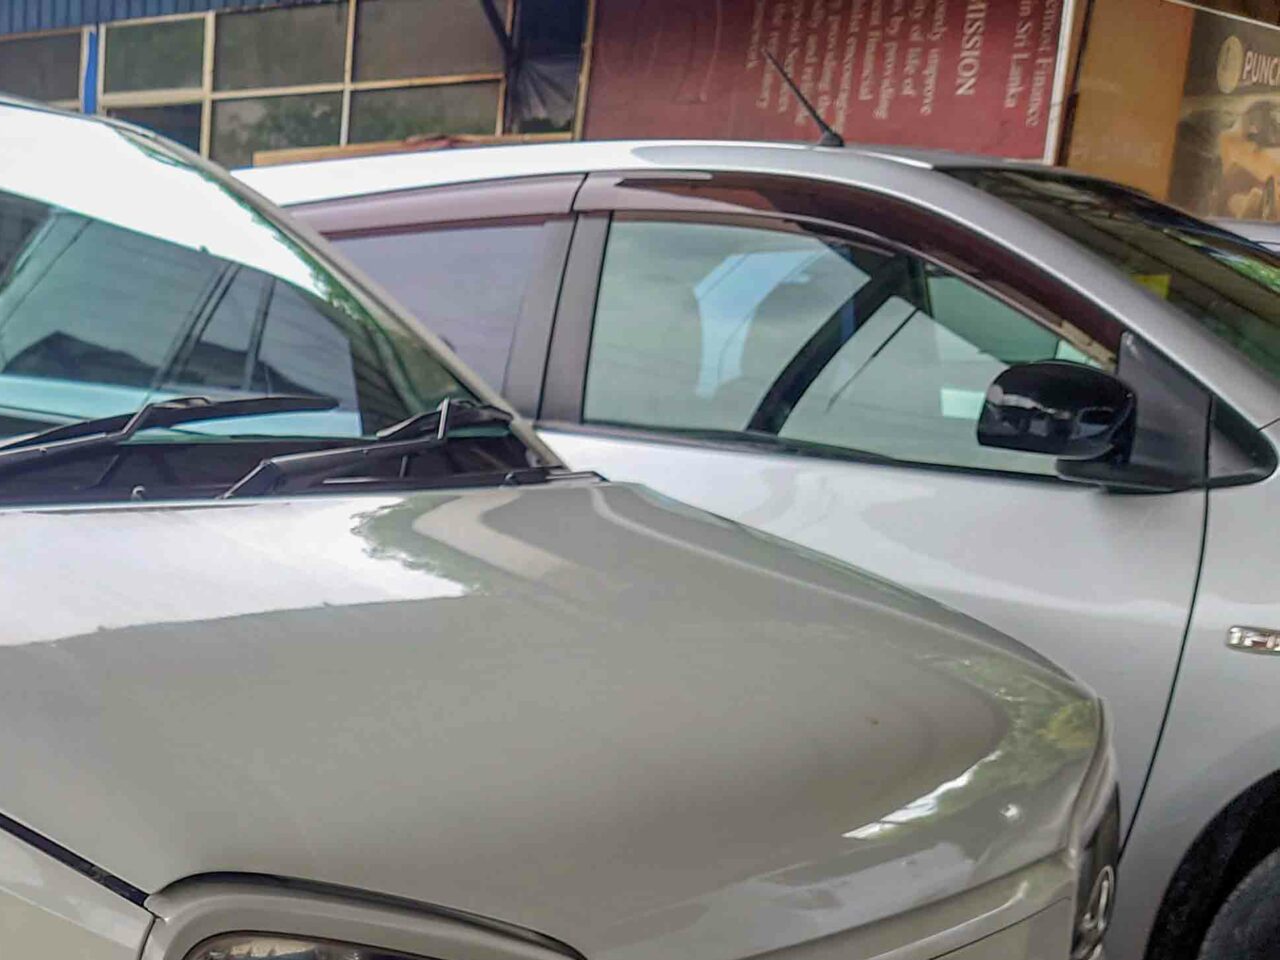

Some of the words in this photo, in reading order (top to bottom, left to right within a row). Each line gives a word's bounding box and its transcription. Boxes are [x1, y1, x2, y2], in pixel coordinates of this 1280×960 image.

[1013, 21, 1032, 48] Sri
[1005, 53, 1031, 108] Lanka
[1025, 57, 1053, 129] Finance
